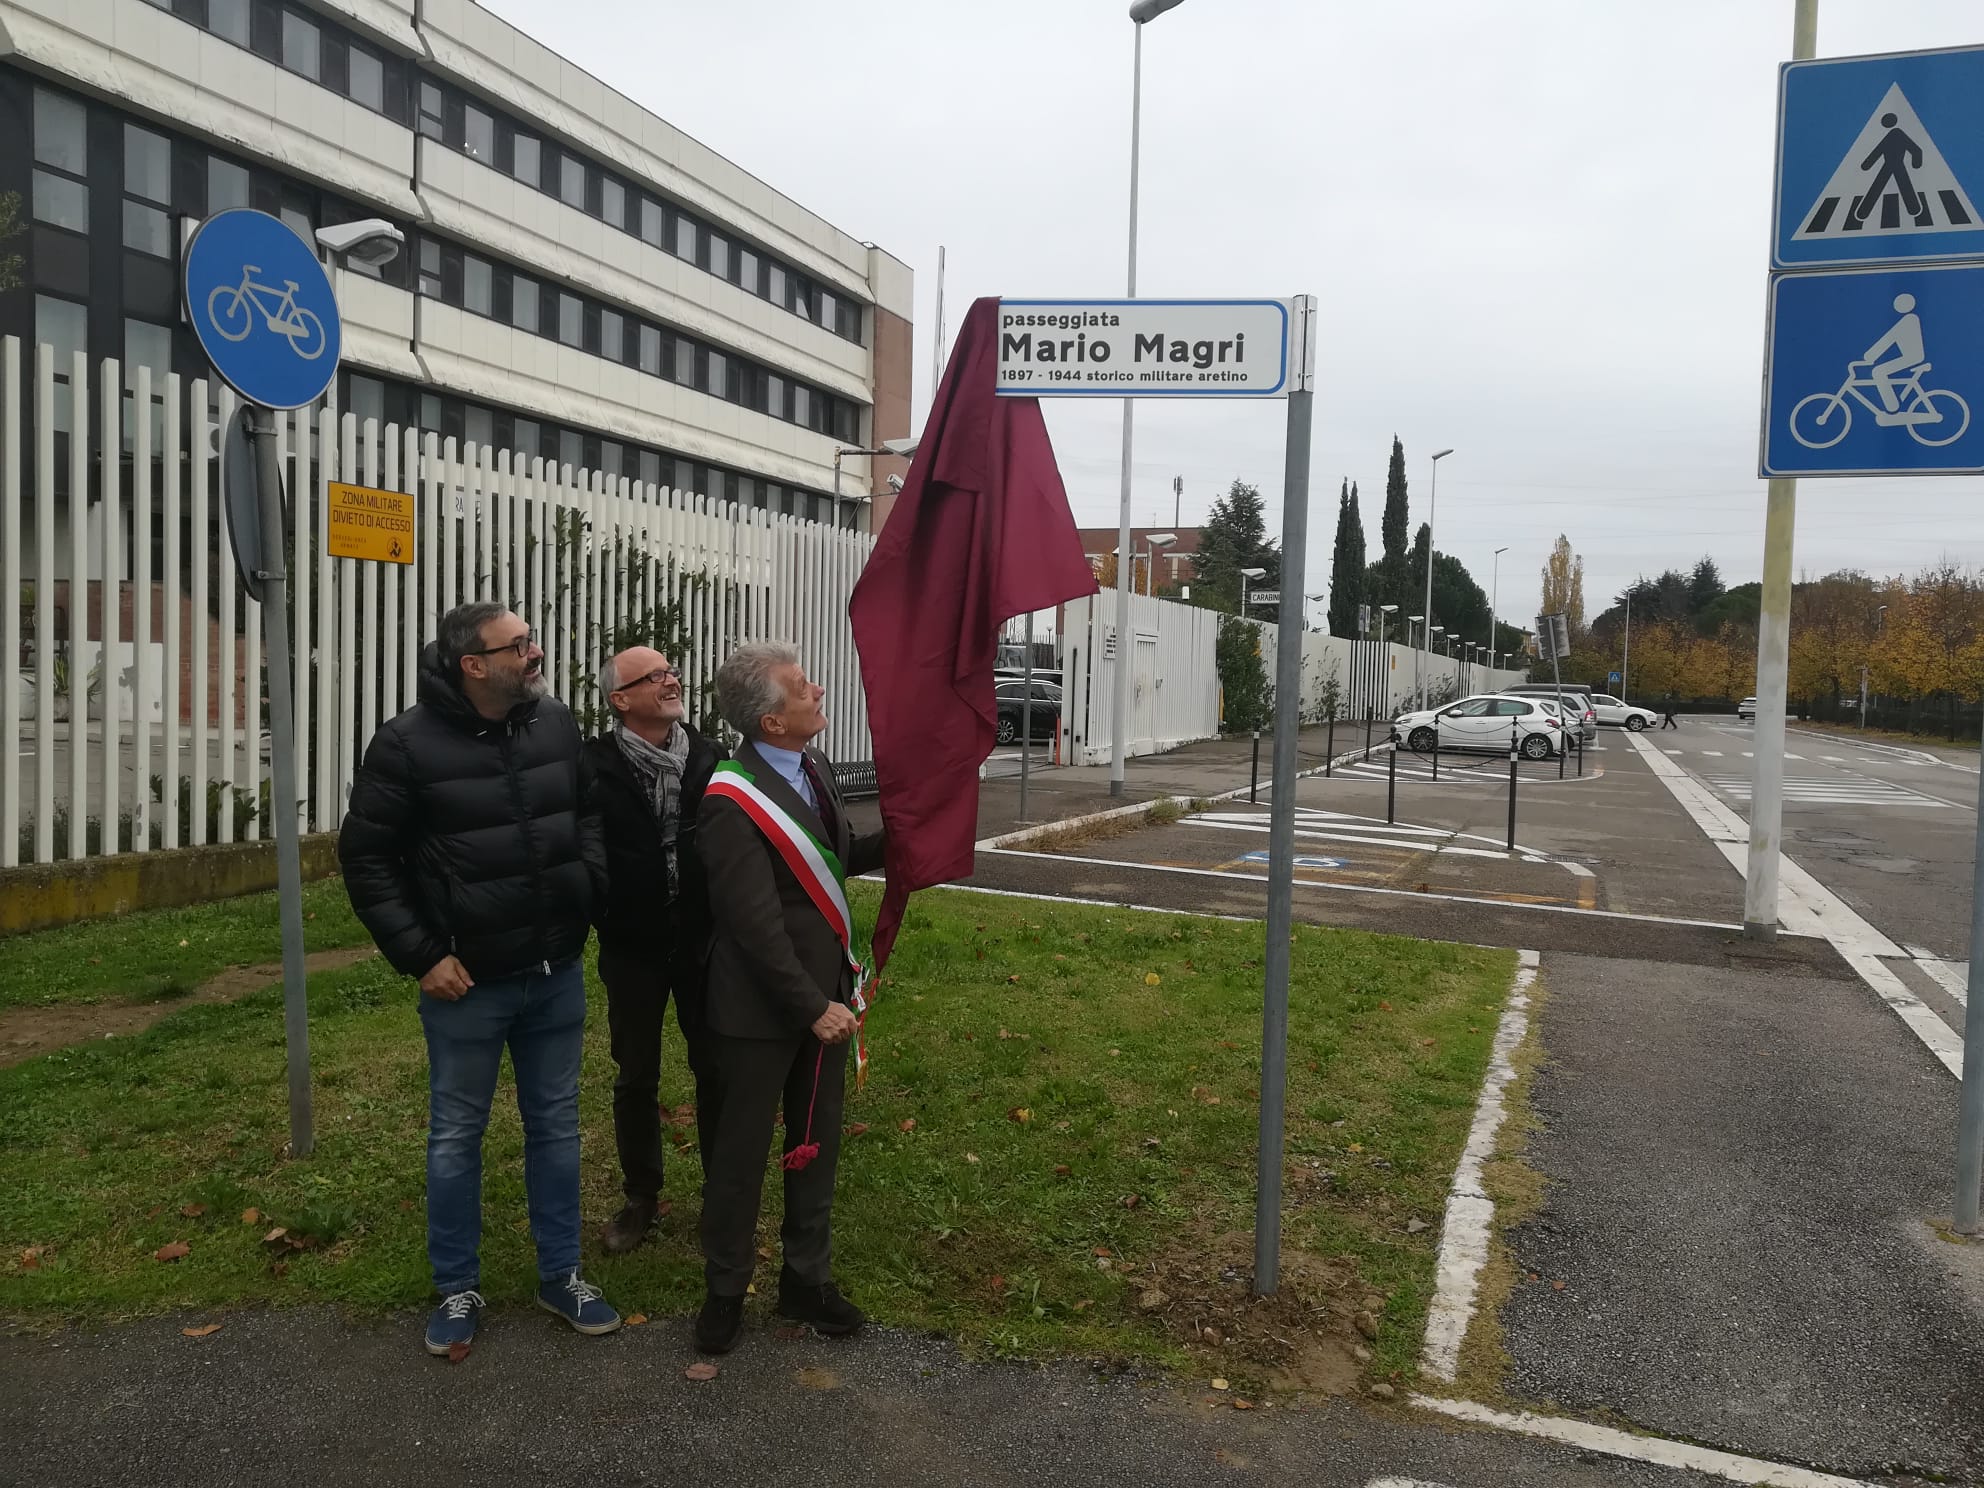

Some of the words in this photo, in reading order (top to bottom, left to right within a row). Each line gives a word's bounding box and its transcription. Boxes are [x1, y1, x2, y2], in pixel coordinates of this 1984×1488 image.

[1003, 312, 1119, 329] passeggiata
[1002, 333, 1110, 362] Mario
[1134, 333, 1244, 369] Magri
[1002, 370, 1033, 381] 1897
[1049, 370, 1081, 381] 1944
[1087, 371, 1134, 382] storico
[1140, 371, 1192, 382] militare
[1199, 371, 1248, 382] aretino
[342, 491, 365, 507] ZONA
[366, 495, 403, 513] MILITARE
[333, 509, 365, 527] DIVIETO
[366, 514, 374, 529] DI
[375, 516, 411, 533] ACCESSO
[1252, 593, 1280, 601] CARABIN
